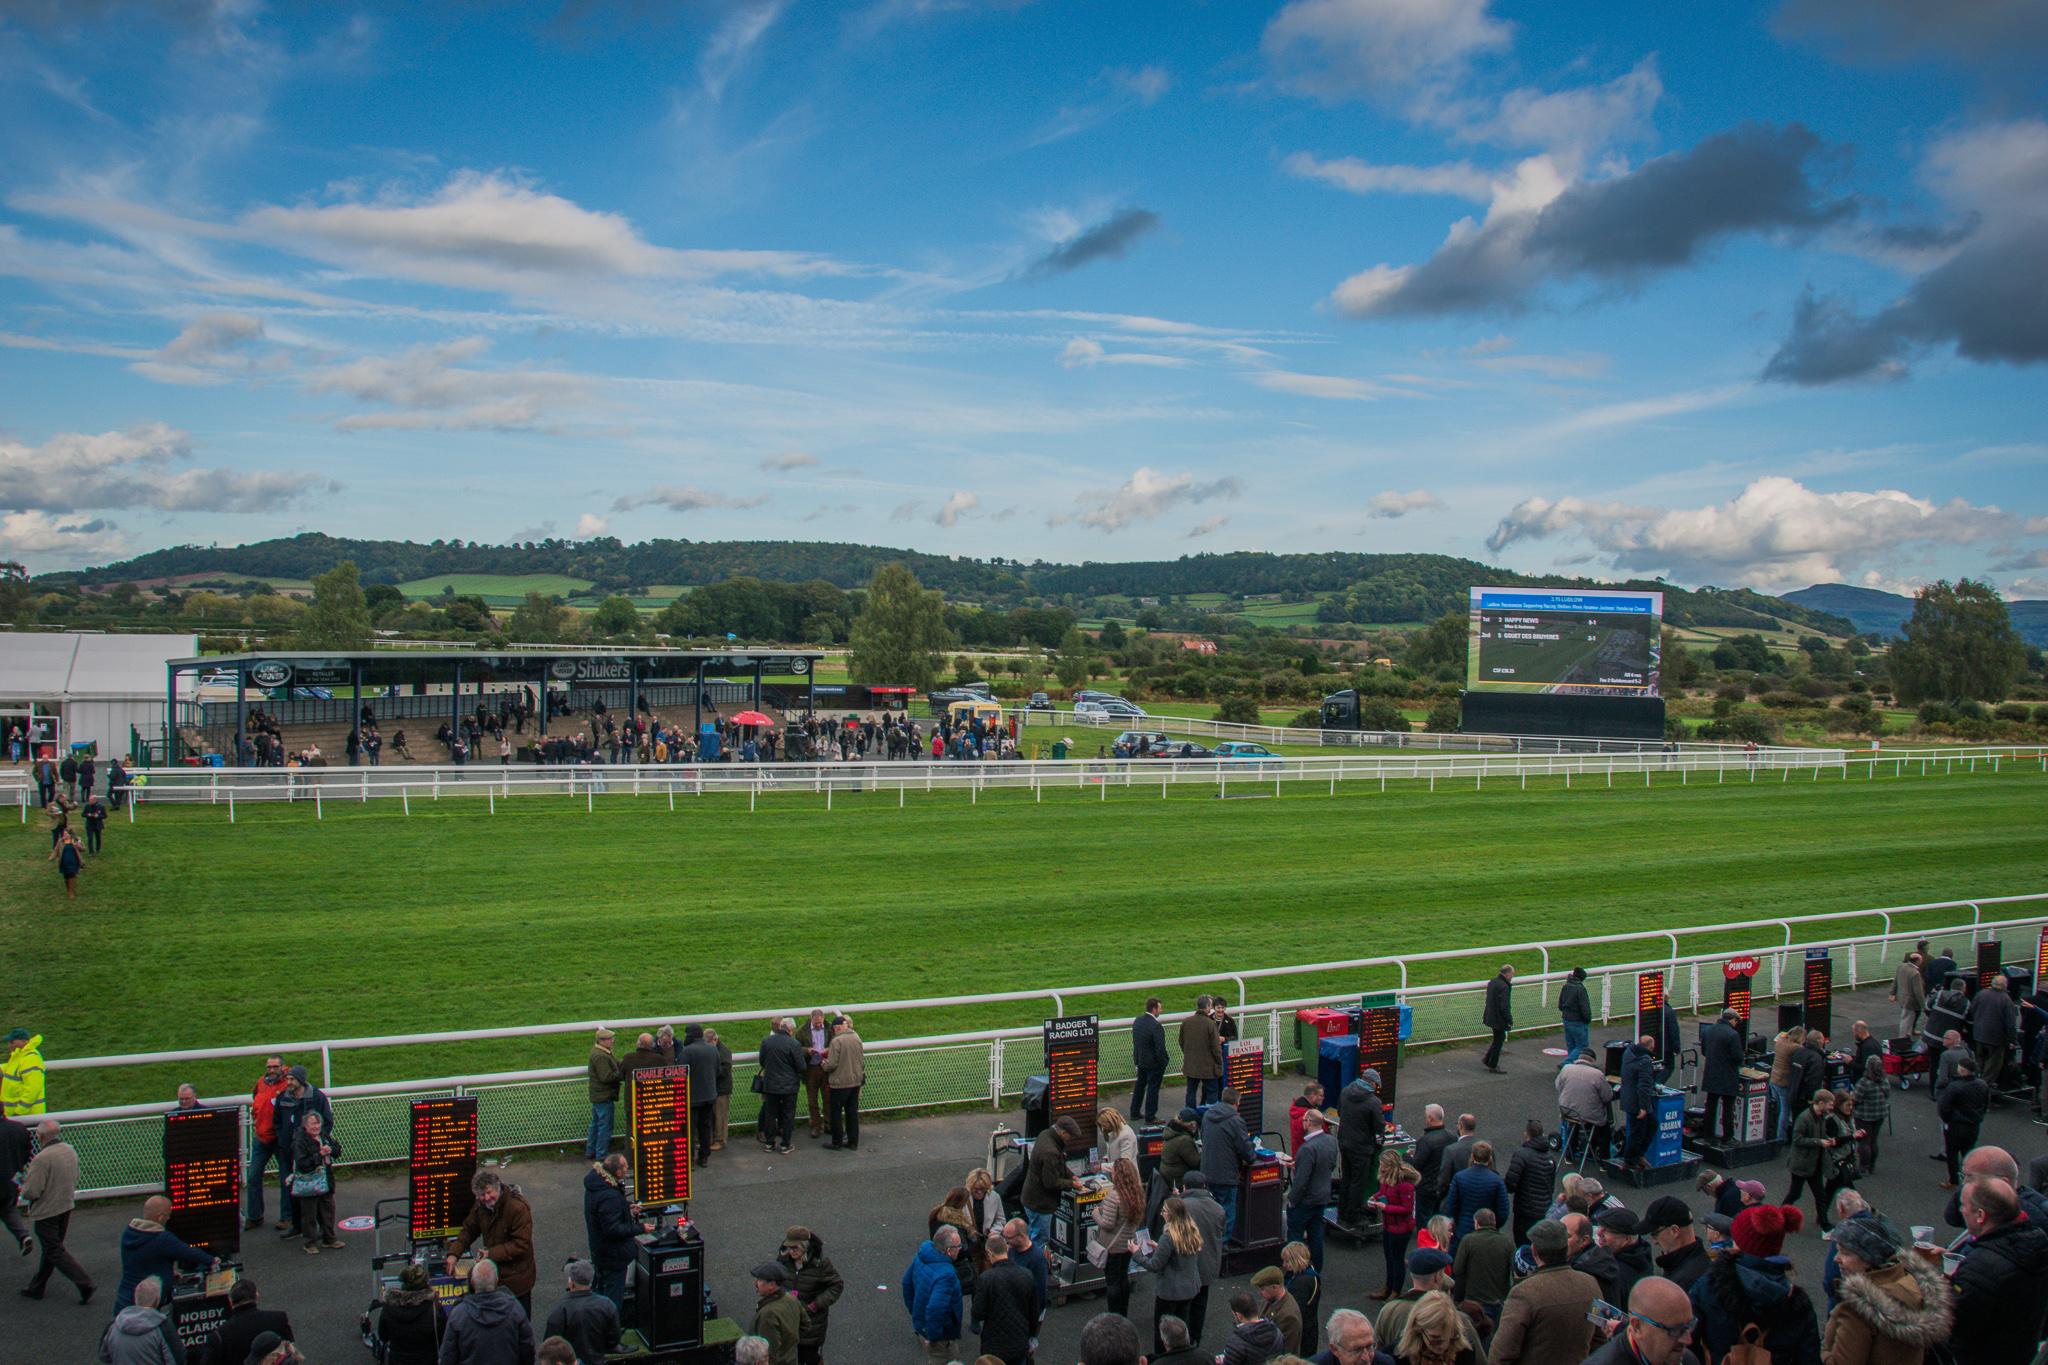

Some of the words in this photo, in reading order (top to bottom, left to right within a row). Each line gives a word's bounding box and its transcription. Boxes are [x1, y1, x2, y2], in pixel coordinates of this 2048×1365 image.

[577, 660, 631, 678] Shukers
[262, 672, 285, 680] ROVER
[1729, 961, 1753, 971] PINNO
[1055, 1020, 1087, 1030] BADGER
[1049, 1029, 1078, 1040] RACING
[1079, 1028, 1094, 1037] LTD
[1232, 1045, 1261, 1054] TRANTER
[635, 1068, 665, 1080] CHARLIE
[664, 1066, 687, 1077] CHASE
[1665, 1111, 1678, 1120] GLEN
[1660, 1120, 1681, 1131] GRAHAM
[1080, 1192, 1106, 1201] FORECA
[664, 1263, 689, 1272] TAKEN
[180, 1307, 225, 1323] NOBBY
